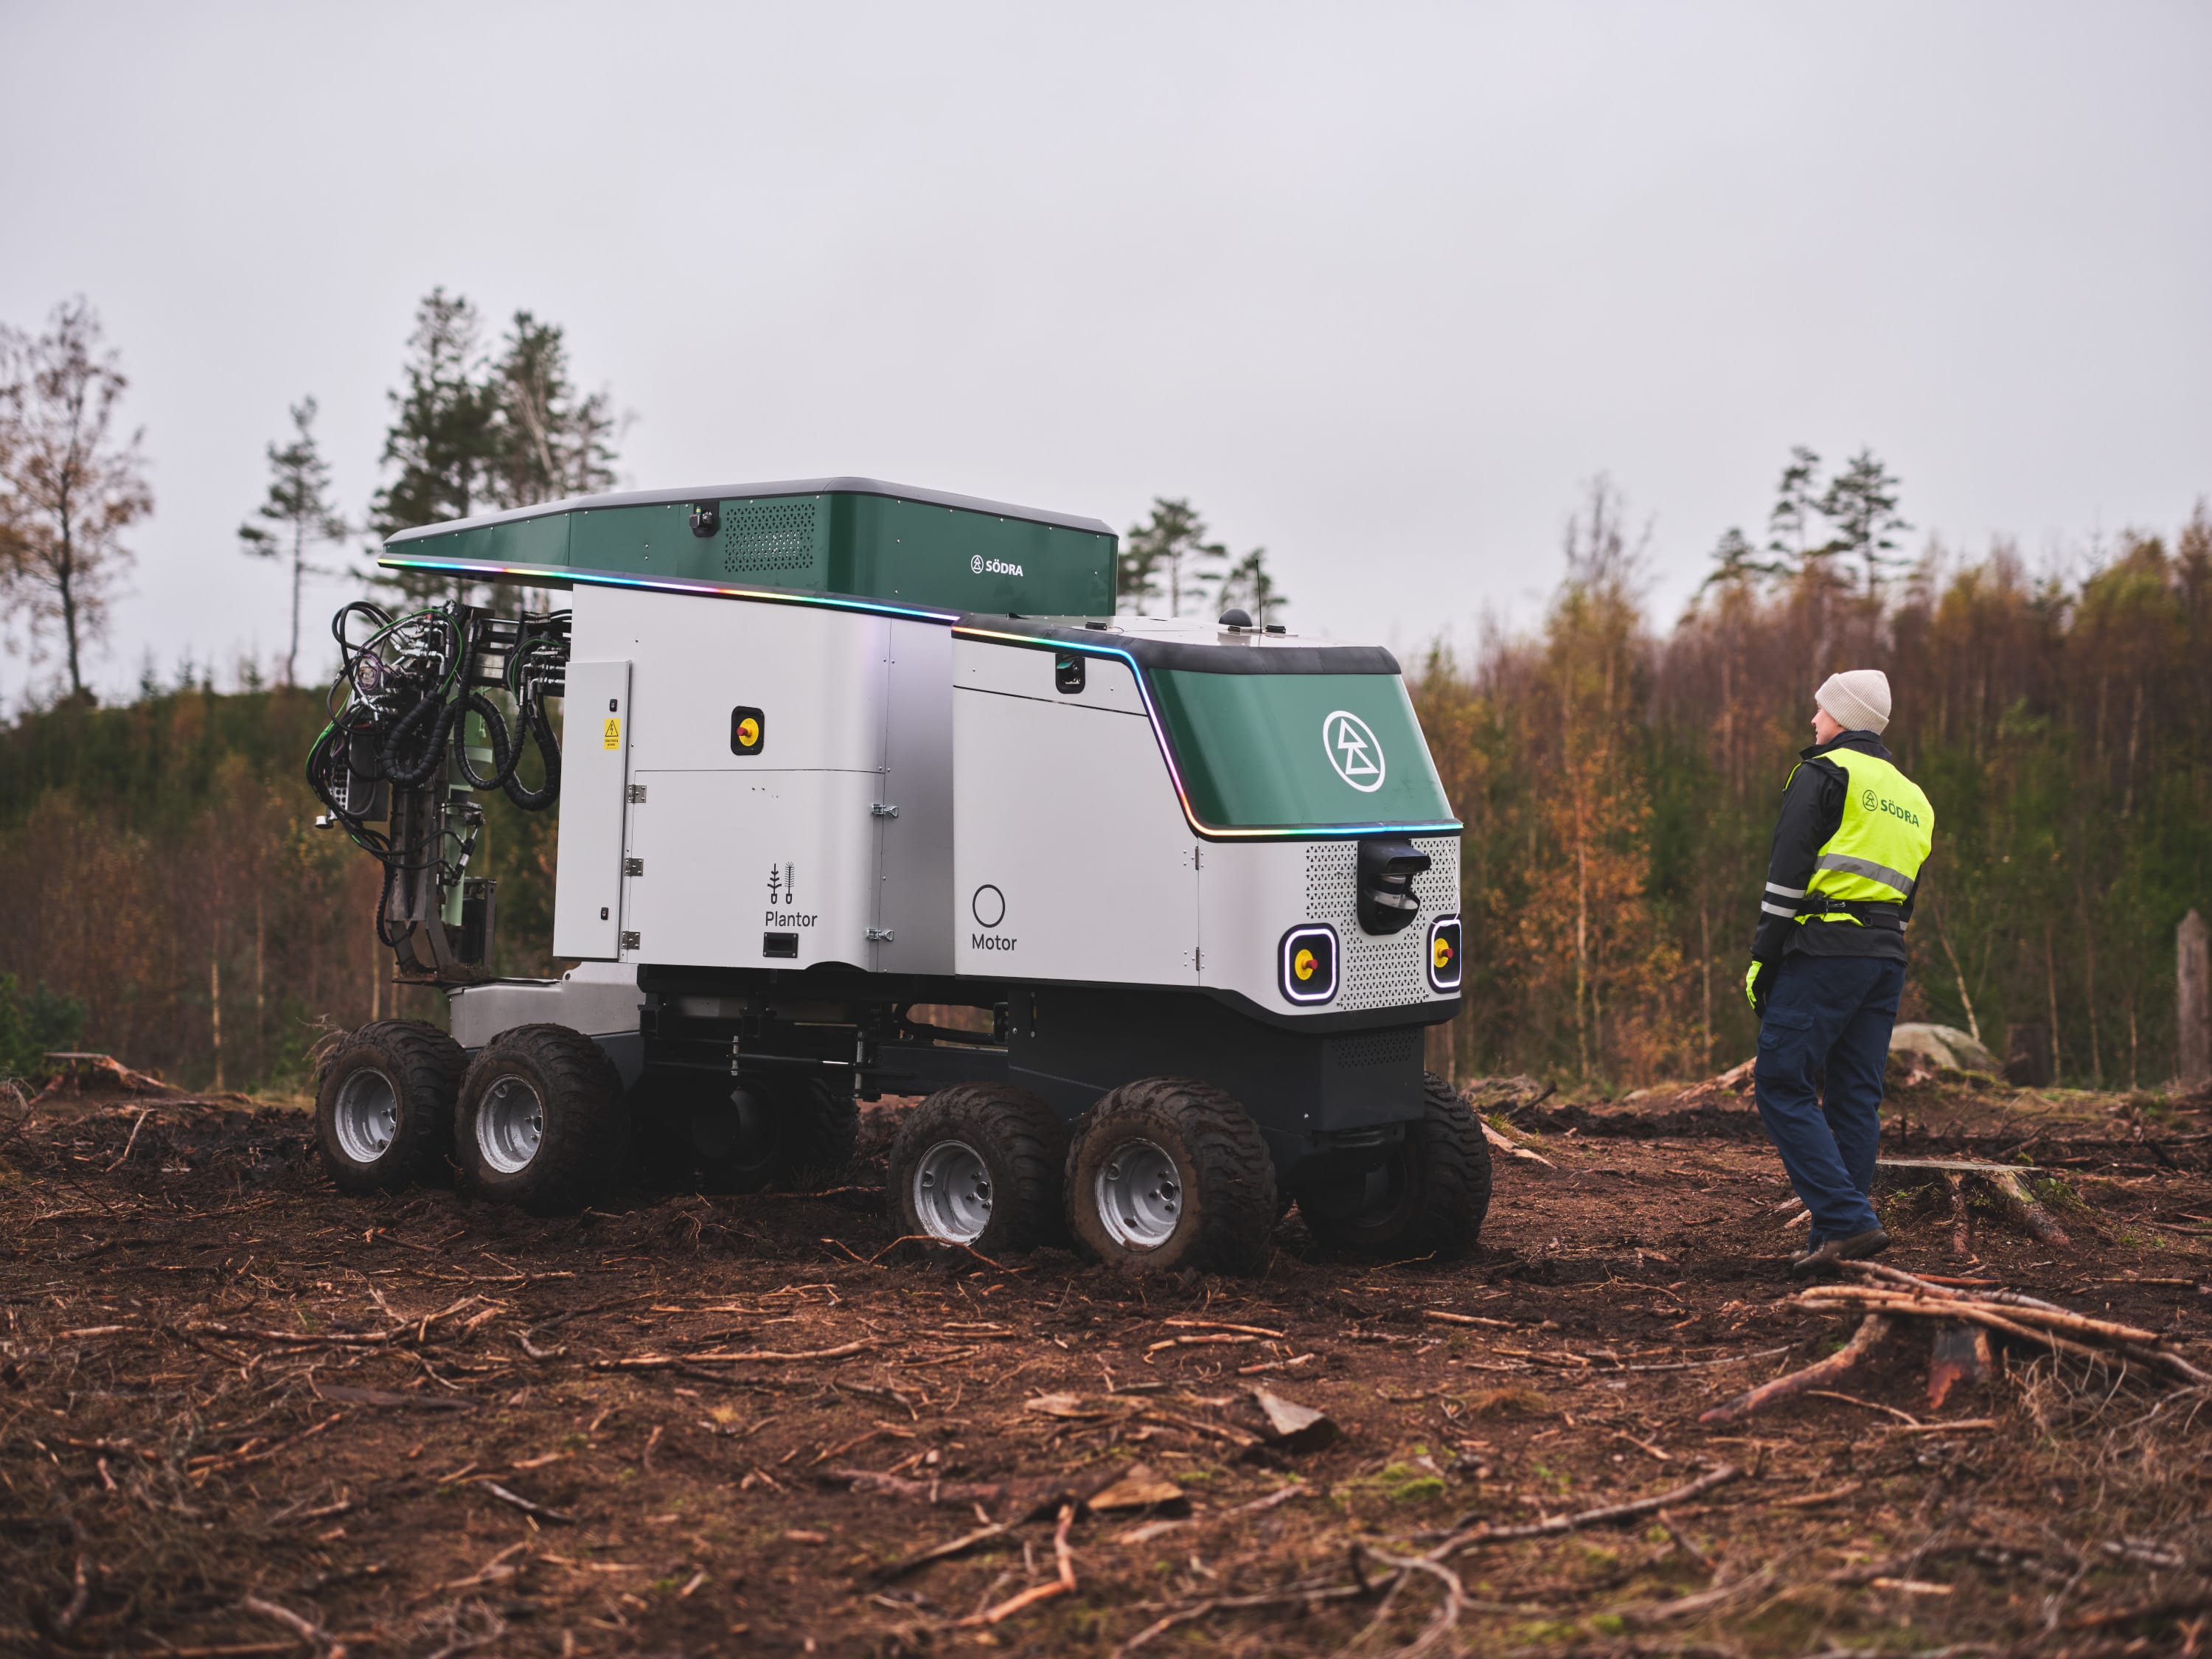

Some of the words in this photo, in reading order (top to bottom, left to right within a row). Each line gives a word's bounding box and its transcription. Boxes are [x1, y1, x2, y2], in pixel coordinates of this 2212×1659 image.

[986, 558, 1023, 577] SÖDRA
[1880, 799, 1919, 827] SÖDRA
[765, 911, 818, 927] Plantor
[972, 933, 1018, 951] Motor
